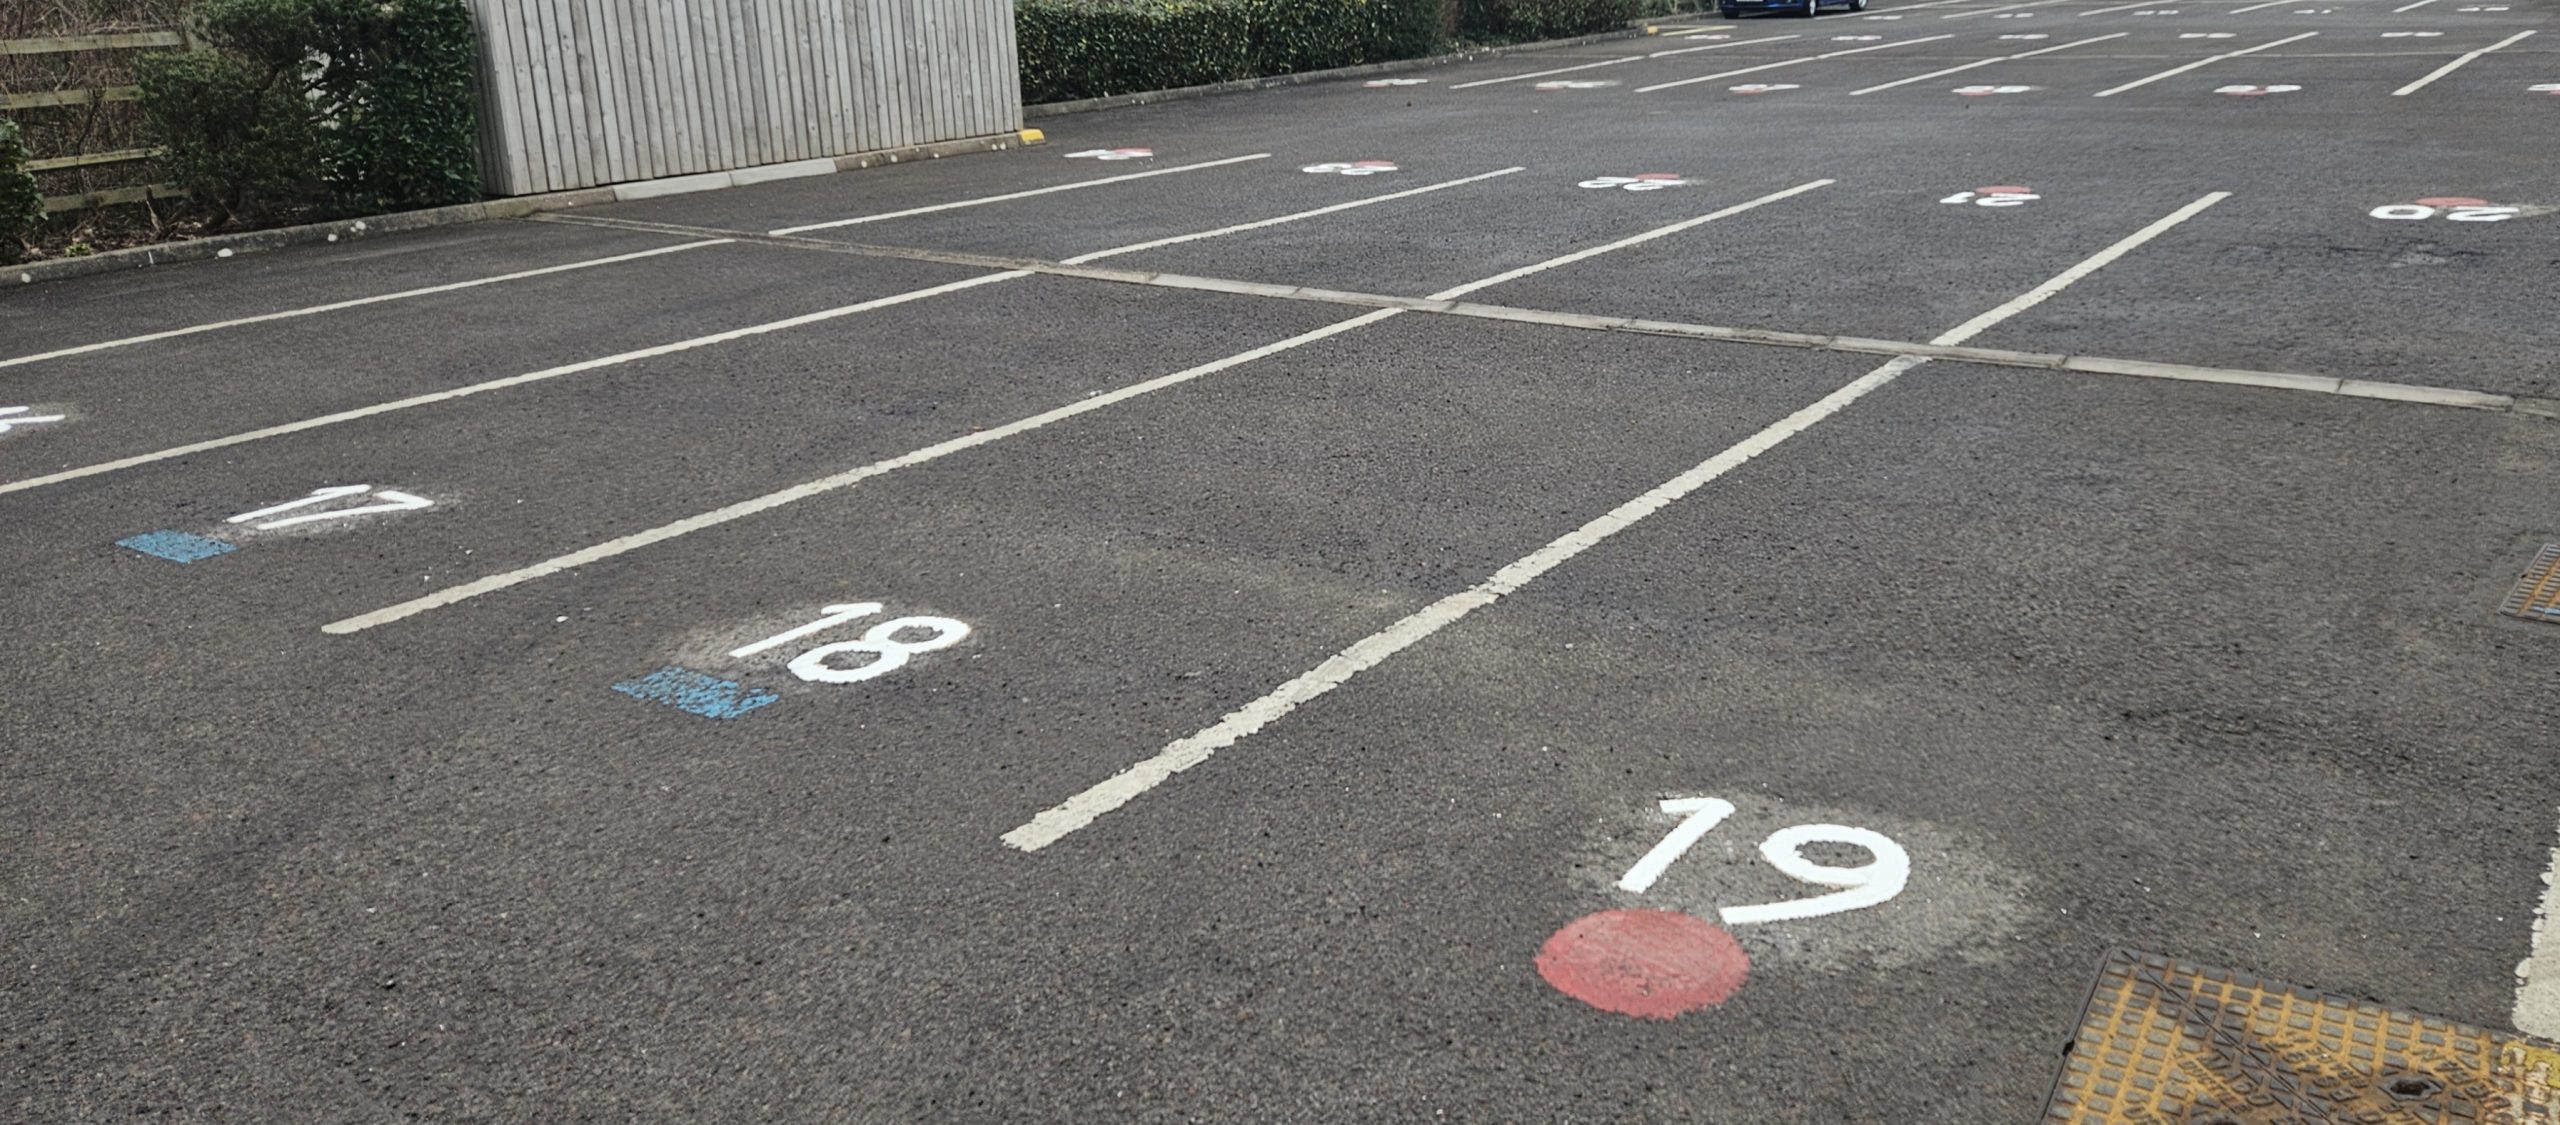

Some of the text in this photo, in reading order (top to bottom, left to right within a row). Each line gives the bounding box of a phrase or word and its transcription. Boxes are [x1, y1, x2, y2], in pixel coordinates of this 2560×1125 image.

[1577, 176, 1688, 191] 22
[1939, 192, 2041, 207] 21
[2368, 205, 2521, 222] 20
[227, 484, 435, 531] 17
[727, 602, 972, 684] 18
[1617, 797, 1911, 925] 19
